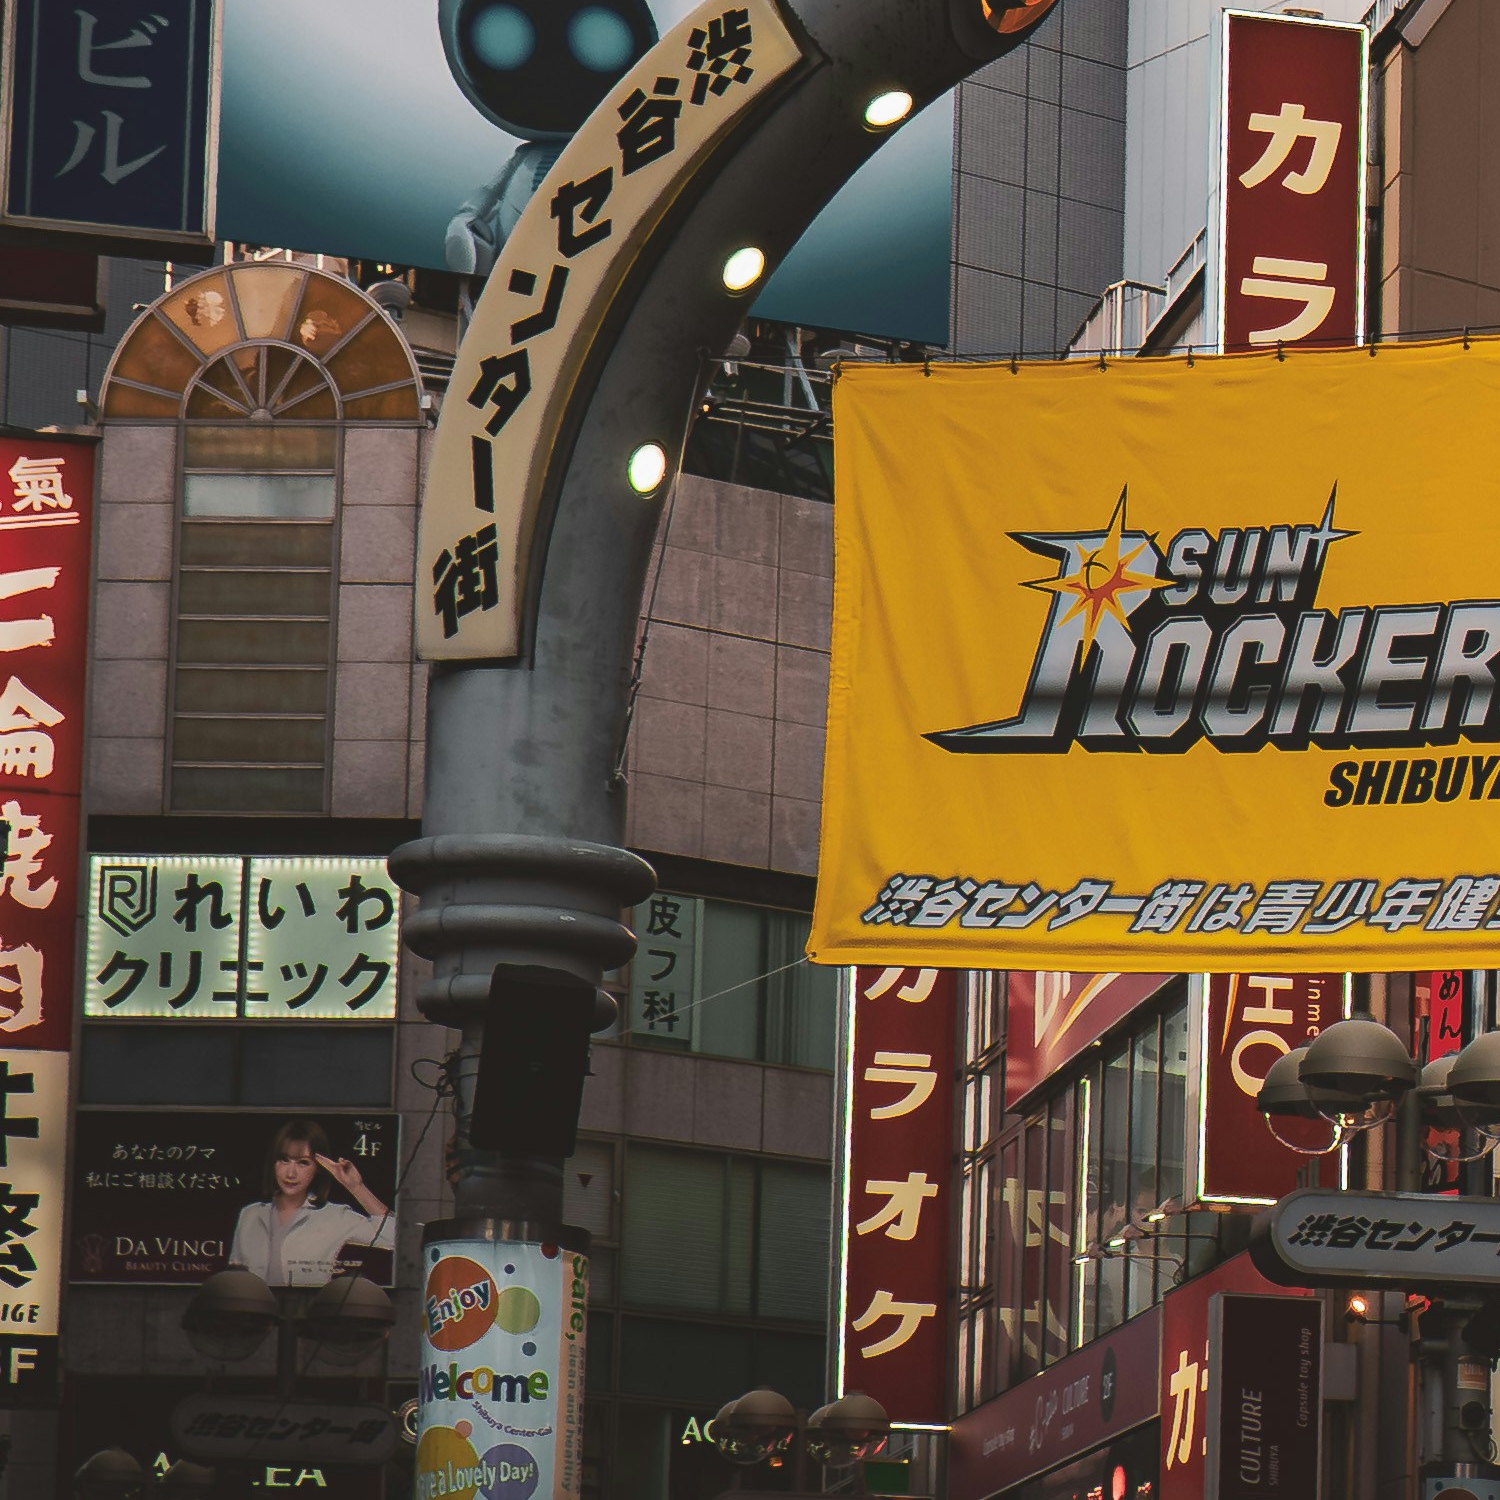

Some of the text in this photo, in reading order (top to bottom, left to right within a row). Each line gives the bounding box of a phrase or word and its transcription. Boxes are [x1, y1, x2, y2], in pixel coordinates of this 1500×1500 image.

[1238, 102, 1343, 346] カラ
[434, 7, 753, 639] 渋谷センター街
[1163, 524, 1345, 608] SUN
[174, 872, 394, 935] れいわ
[96, 949, 394, 1011] クリニック
[646, 897, 683, 1033] 皮フ科
[112, 1143, 216, 1161] あなたのクマ
[353, 1133, 382, 1157] 4F
[85, 1171, 241, 1190] 私にご相談ください
[155, 1236, 225, 1258] VINCI
[426, 1279, 491, 1337] Enjoy
[421, 1362, 550, 1403] Welcome
[1239, 1388, 1263, 1485] CULTURE
[447, 1460, 498, 1494] Lovely
[499, 1461, 535, 1484] Day!
[1268, 1444, 1280, 1488] SHIBUYA
